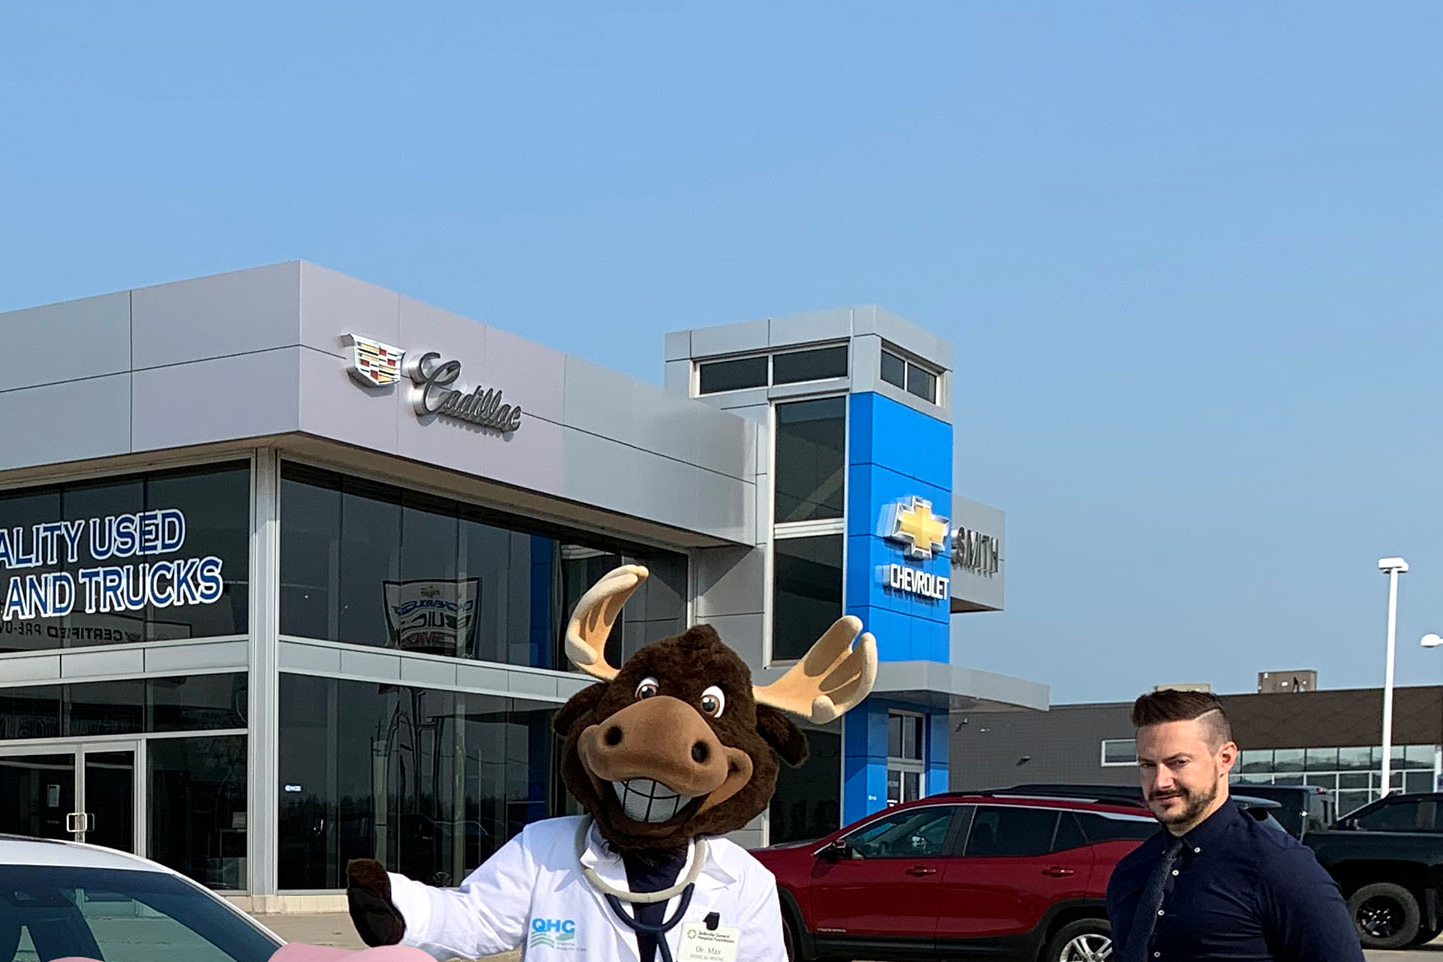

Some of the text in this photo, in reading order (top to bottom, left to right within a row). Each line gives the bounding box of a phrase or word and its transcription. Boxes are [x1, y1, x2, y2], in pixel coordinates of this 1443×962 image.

[418, 352, 522, 432] Cadillac
[89, 508, 187, 560] USED
[955, 526, 999, 574] SMITH
[3, 571, 76, 621] AND
[79, 556, 224, 615] TRUCKS
[890, 563, 949, 600] CHEVROLET
[532, 918, 576, 934] QHC
